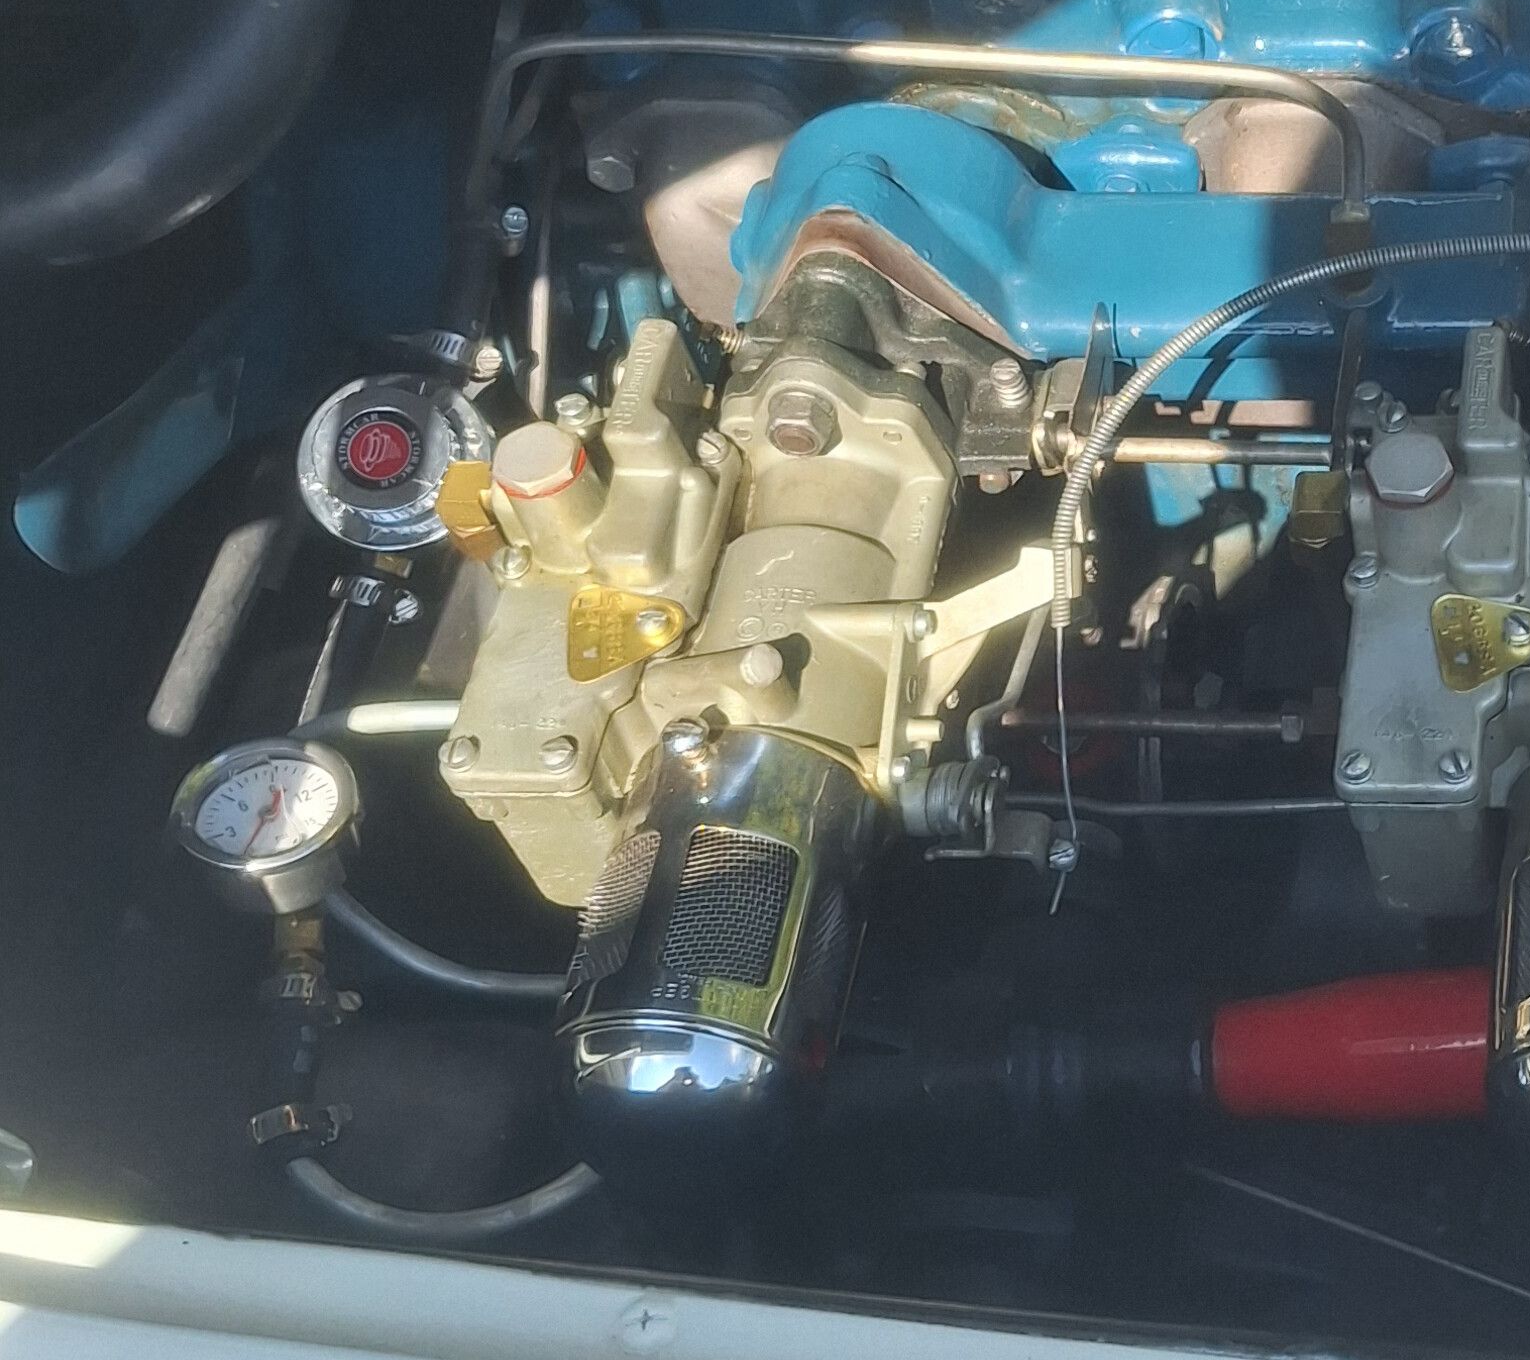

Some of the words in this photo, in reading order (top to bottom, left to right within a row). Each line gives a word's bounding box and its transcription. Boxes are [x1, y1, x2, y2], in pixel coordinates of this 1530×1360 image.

[295, 788, 313, 804] 12
[237, 799, 250, 813] 6
[224, 825, 237, 838] 3
